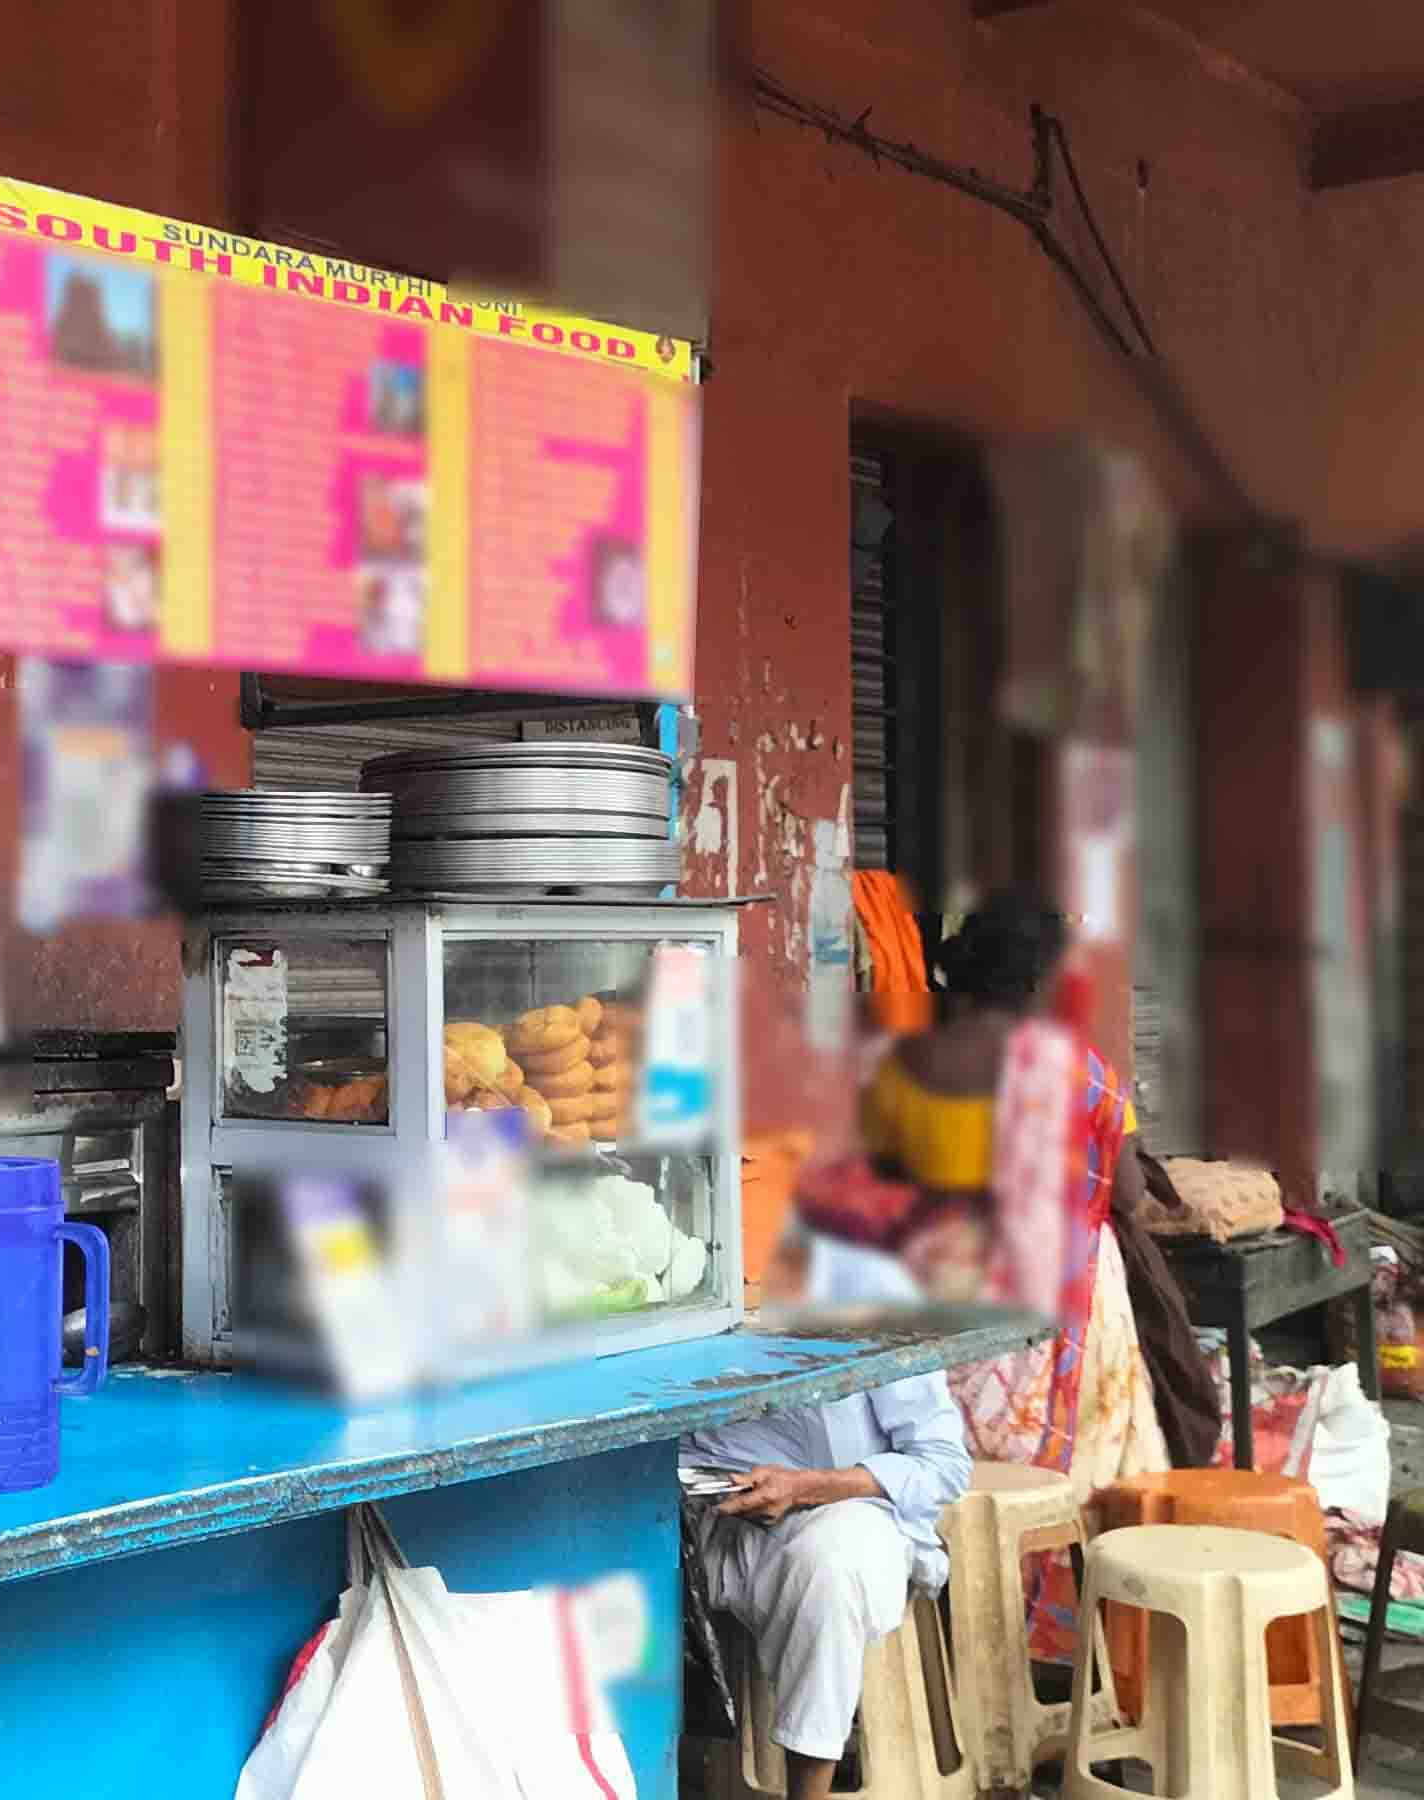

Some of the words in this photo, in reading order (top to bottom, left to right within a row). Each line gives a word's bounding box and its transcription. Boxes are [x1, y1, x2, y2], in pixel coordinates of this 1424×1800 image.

[164, 223, 315, 272] SUNDARA
[326, 261, 431, 296] MURTHI
[264, 264, 472, 326] INDIAN
[499, 314, 635, 358] FOOD
